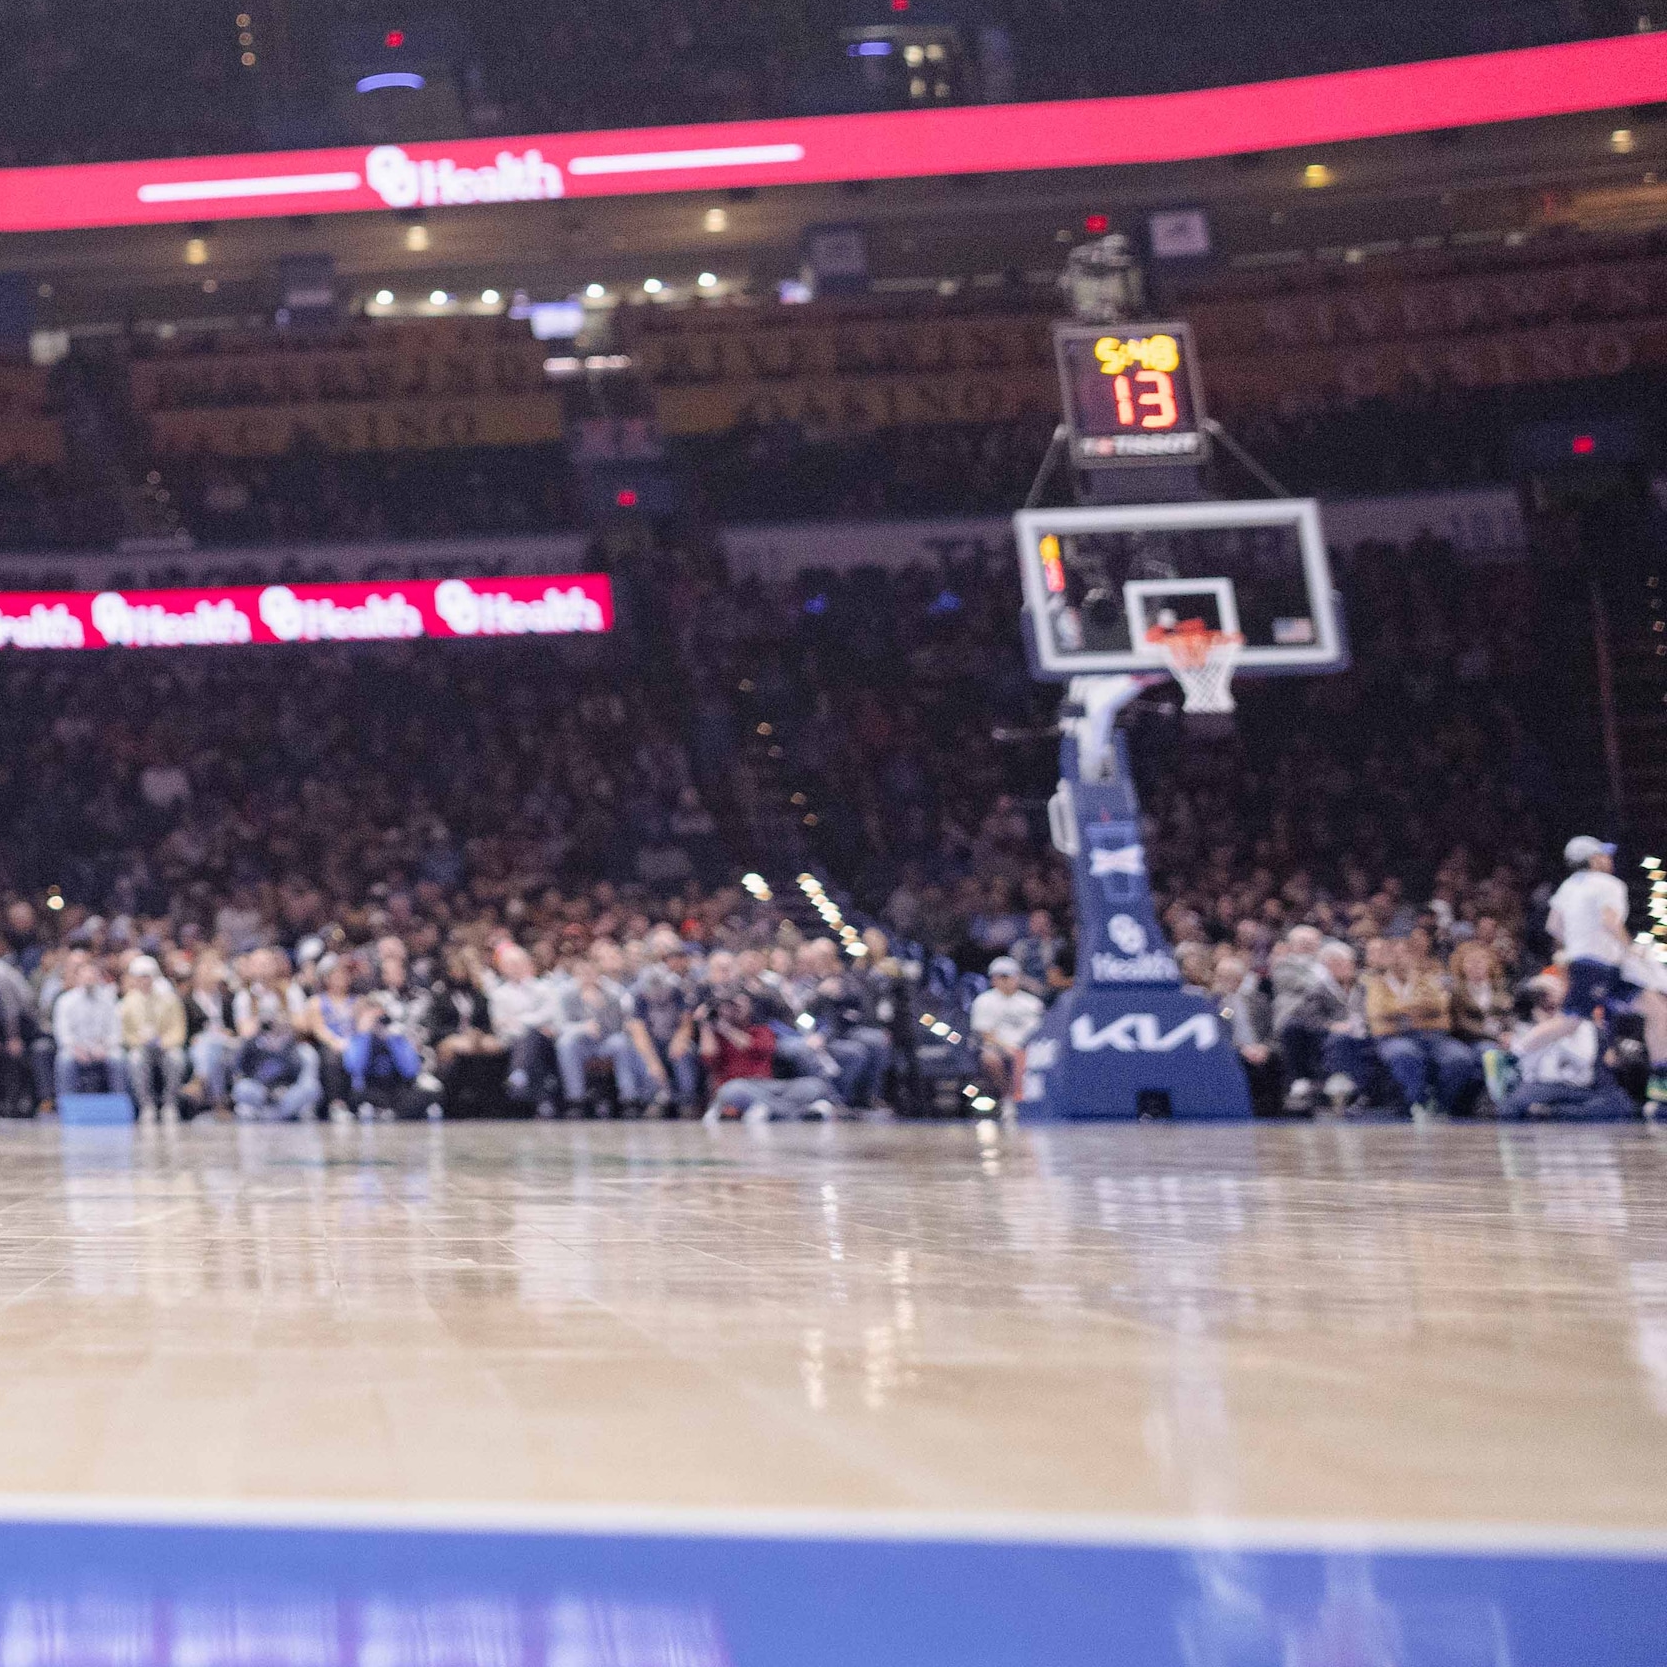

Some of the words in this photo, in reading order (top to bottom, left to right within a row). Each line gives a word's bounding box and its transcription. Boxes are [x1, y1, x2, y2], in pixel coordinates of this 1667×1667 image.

[421, 147, 565, 205] Health
[1113, 369, 1179, 429] 13
[126, 597, 253, 647] Health
[299, 591, 424, 641] Health
[478, 585, 605, 635] Health
